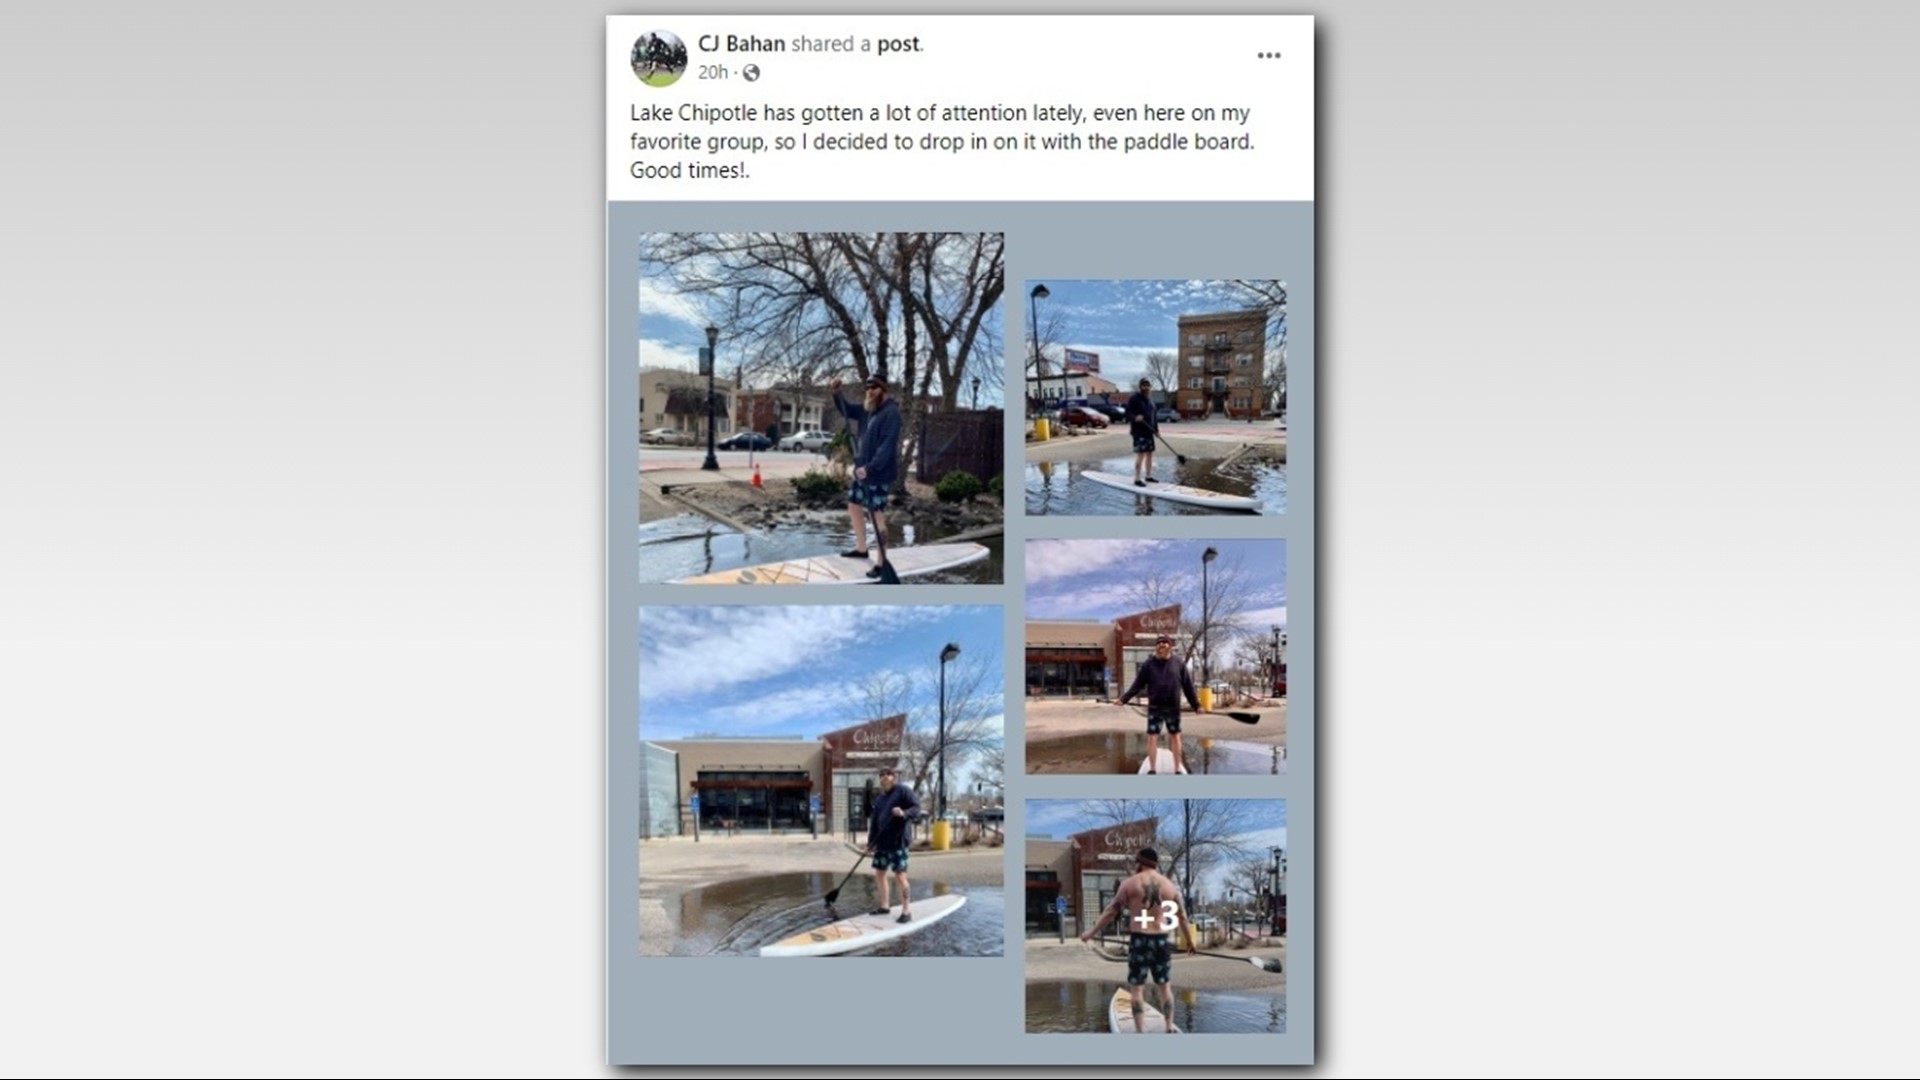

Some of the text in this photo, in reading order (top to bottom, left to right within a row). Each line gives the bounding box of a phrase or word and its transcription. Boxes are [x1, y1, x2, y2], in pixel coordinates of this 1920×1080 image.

[698, 34, 924, 57] CJ Bahan shared a post.
[698, 63, 729, 81] 20h
[631, 103, 1251, 126] Lake Chipotle has gotten a lot of attention lately, even here on my
[630, 132, 1255, 155] favorite group, so I decided to drop in on it with the paddle board.
[629, 160, 750, 179] Good times!.
[853, 728, 900, 749] Chipotle
